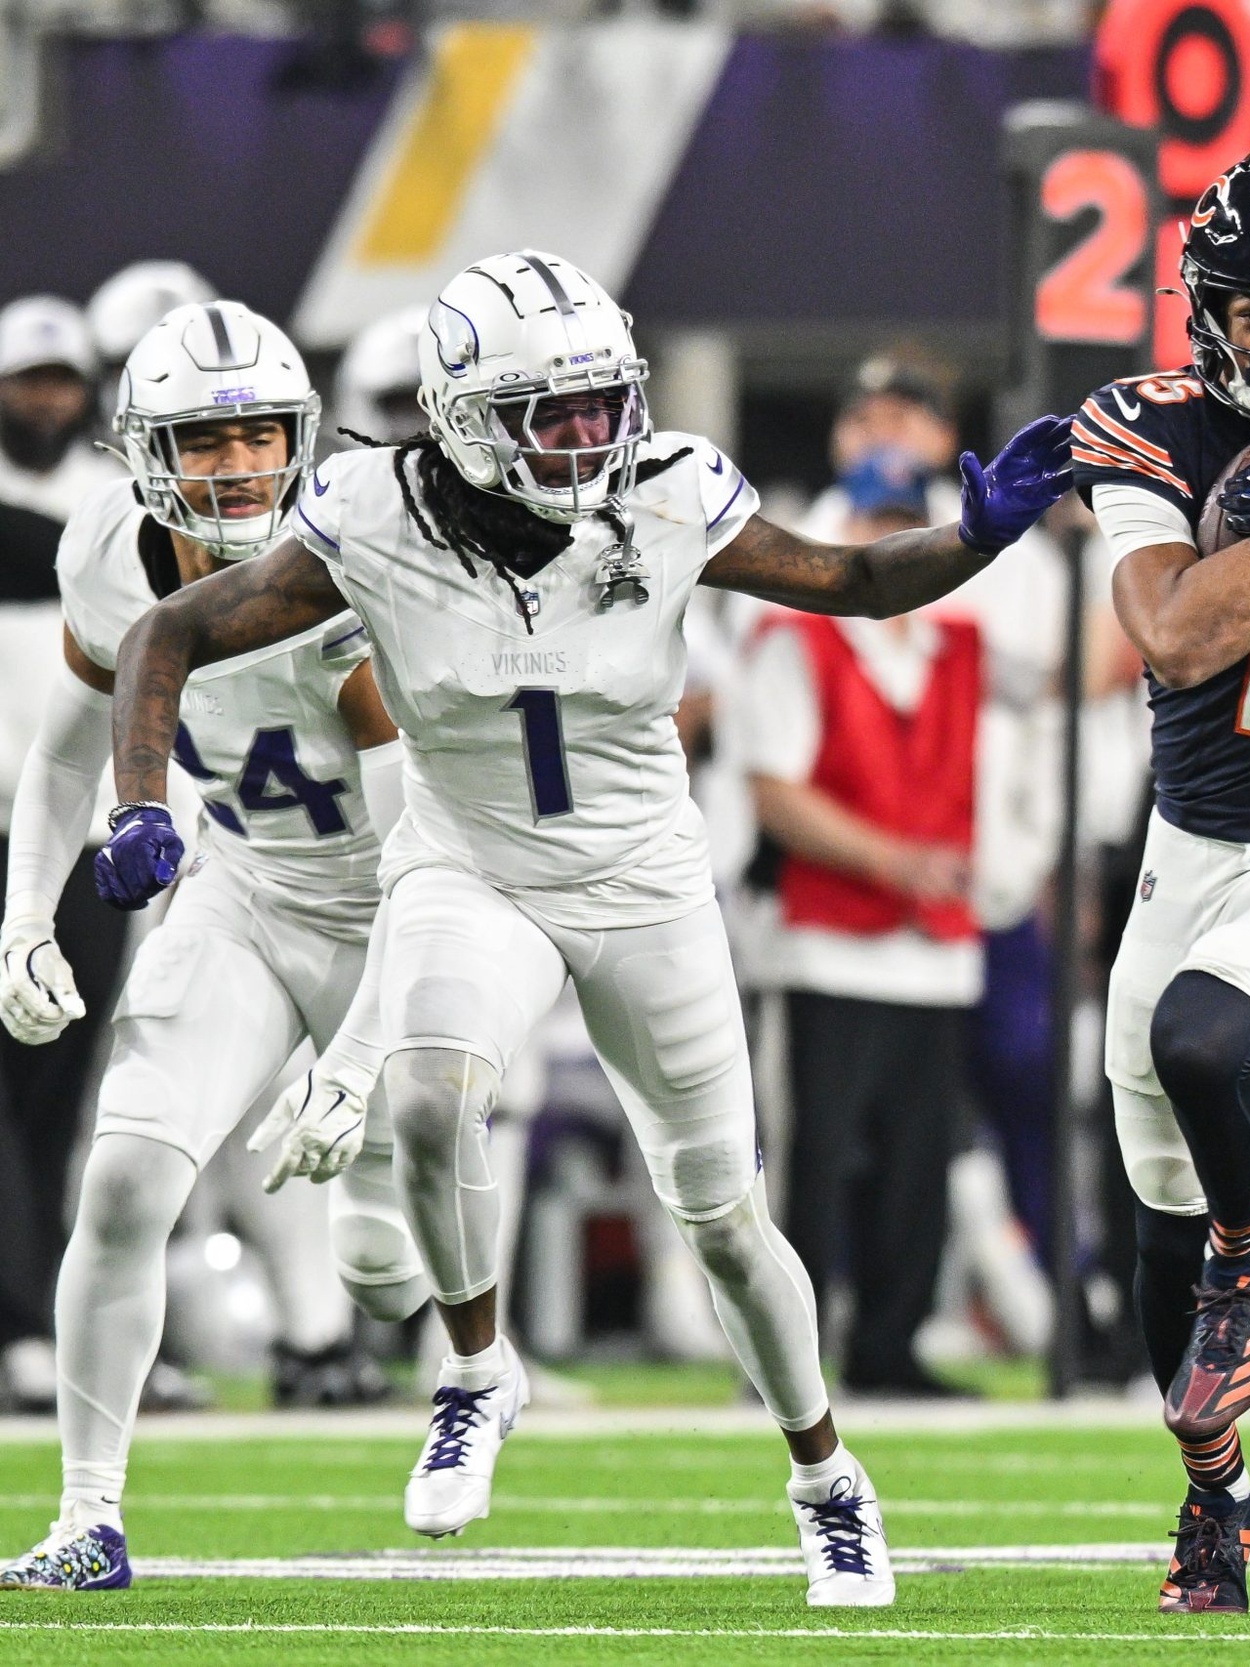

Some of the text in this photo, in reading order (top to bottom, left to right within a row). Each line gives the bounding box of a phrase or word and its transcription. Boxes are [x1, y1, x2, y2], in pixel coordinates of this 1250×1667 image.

[1036, 150, 1147, 345] 2
[568, 352, 595, 366] VIKINGS
[491, 651, 568, 676] VIKINGS
[501, 686, 574, 827] 1
